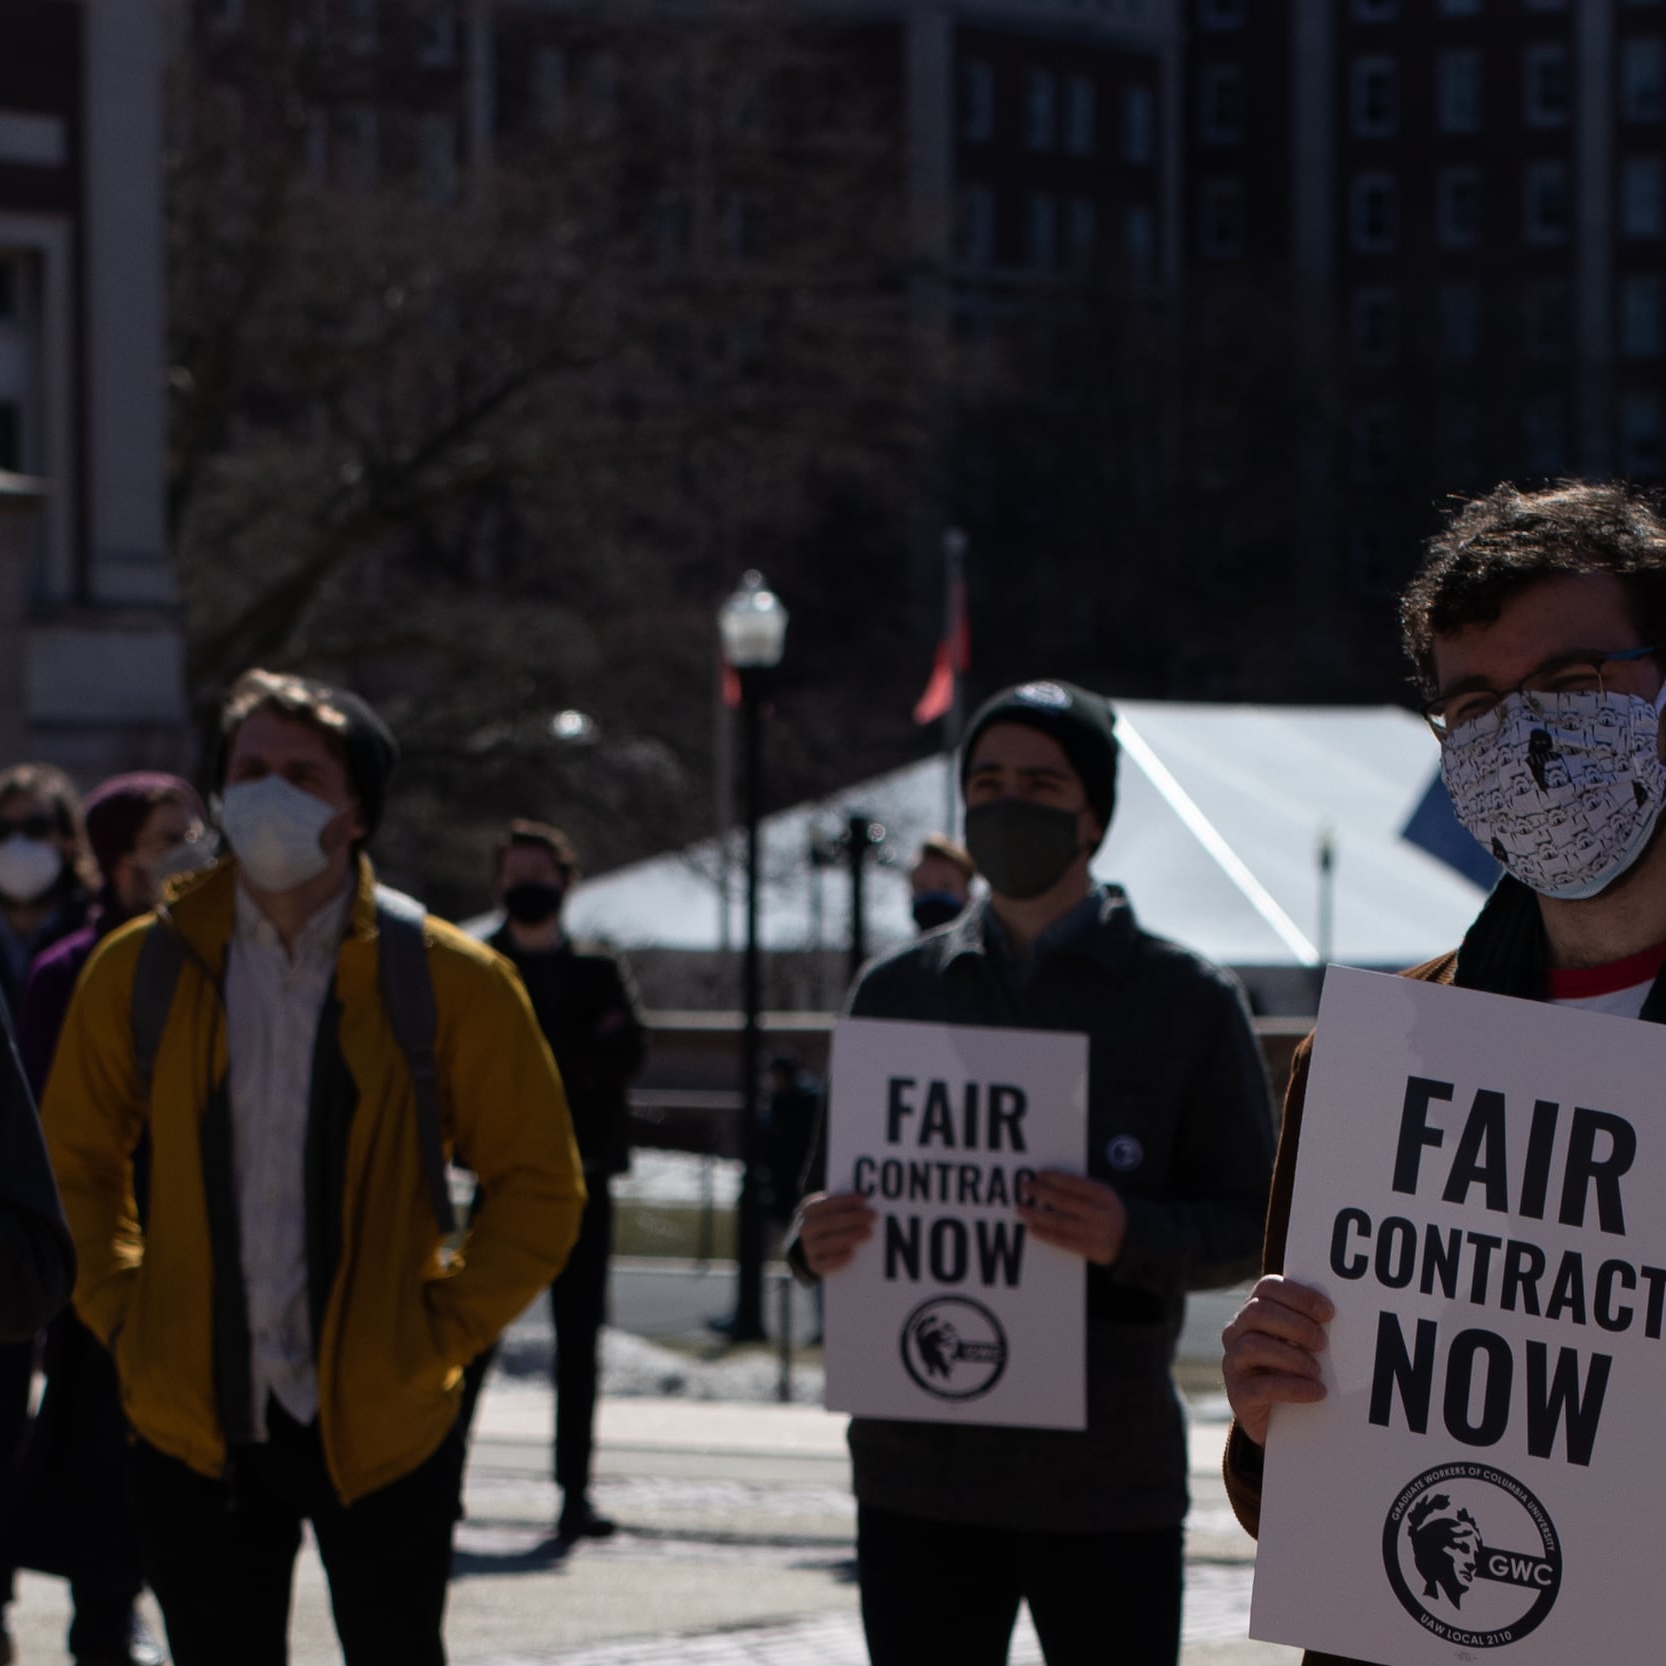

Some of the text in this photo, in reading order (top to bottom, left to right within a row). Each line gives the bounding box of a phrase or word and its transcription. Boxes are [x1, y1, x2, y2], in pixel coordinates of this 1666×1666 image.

[886, 1075, 1028, 1152] FAIR
[855, 1157, 1037, 1208] CONTRAC
[1390, 1074, 1639, 1236] FAIR
[885, 1215, 1027, 1288] NOW
[1368, 1311, 1612, 1467] NOW
[1391, 1465, 1555, 1552] GRADUATE WORKERS OF COLUMBIA UNIVERSITY
[1488, 1554, 1554, 1586] GWC
[1420, 1612, 1512, 1646] UAW LOCAL 2110
